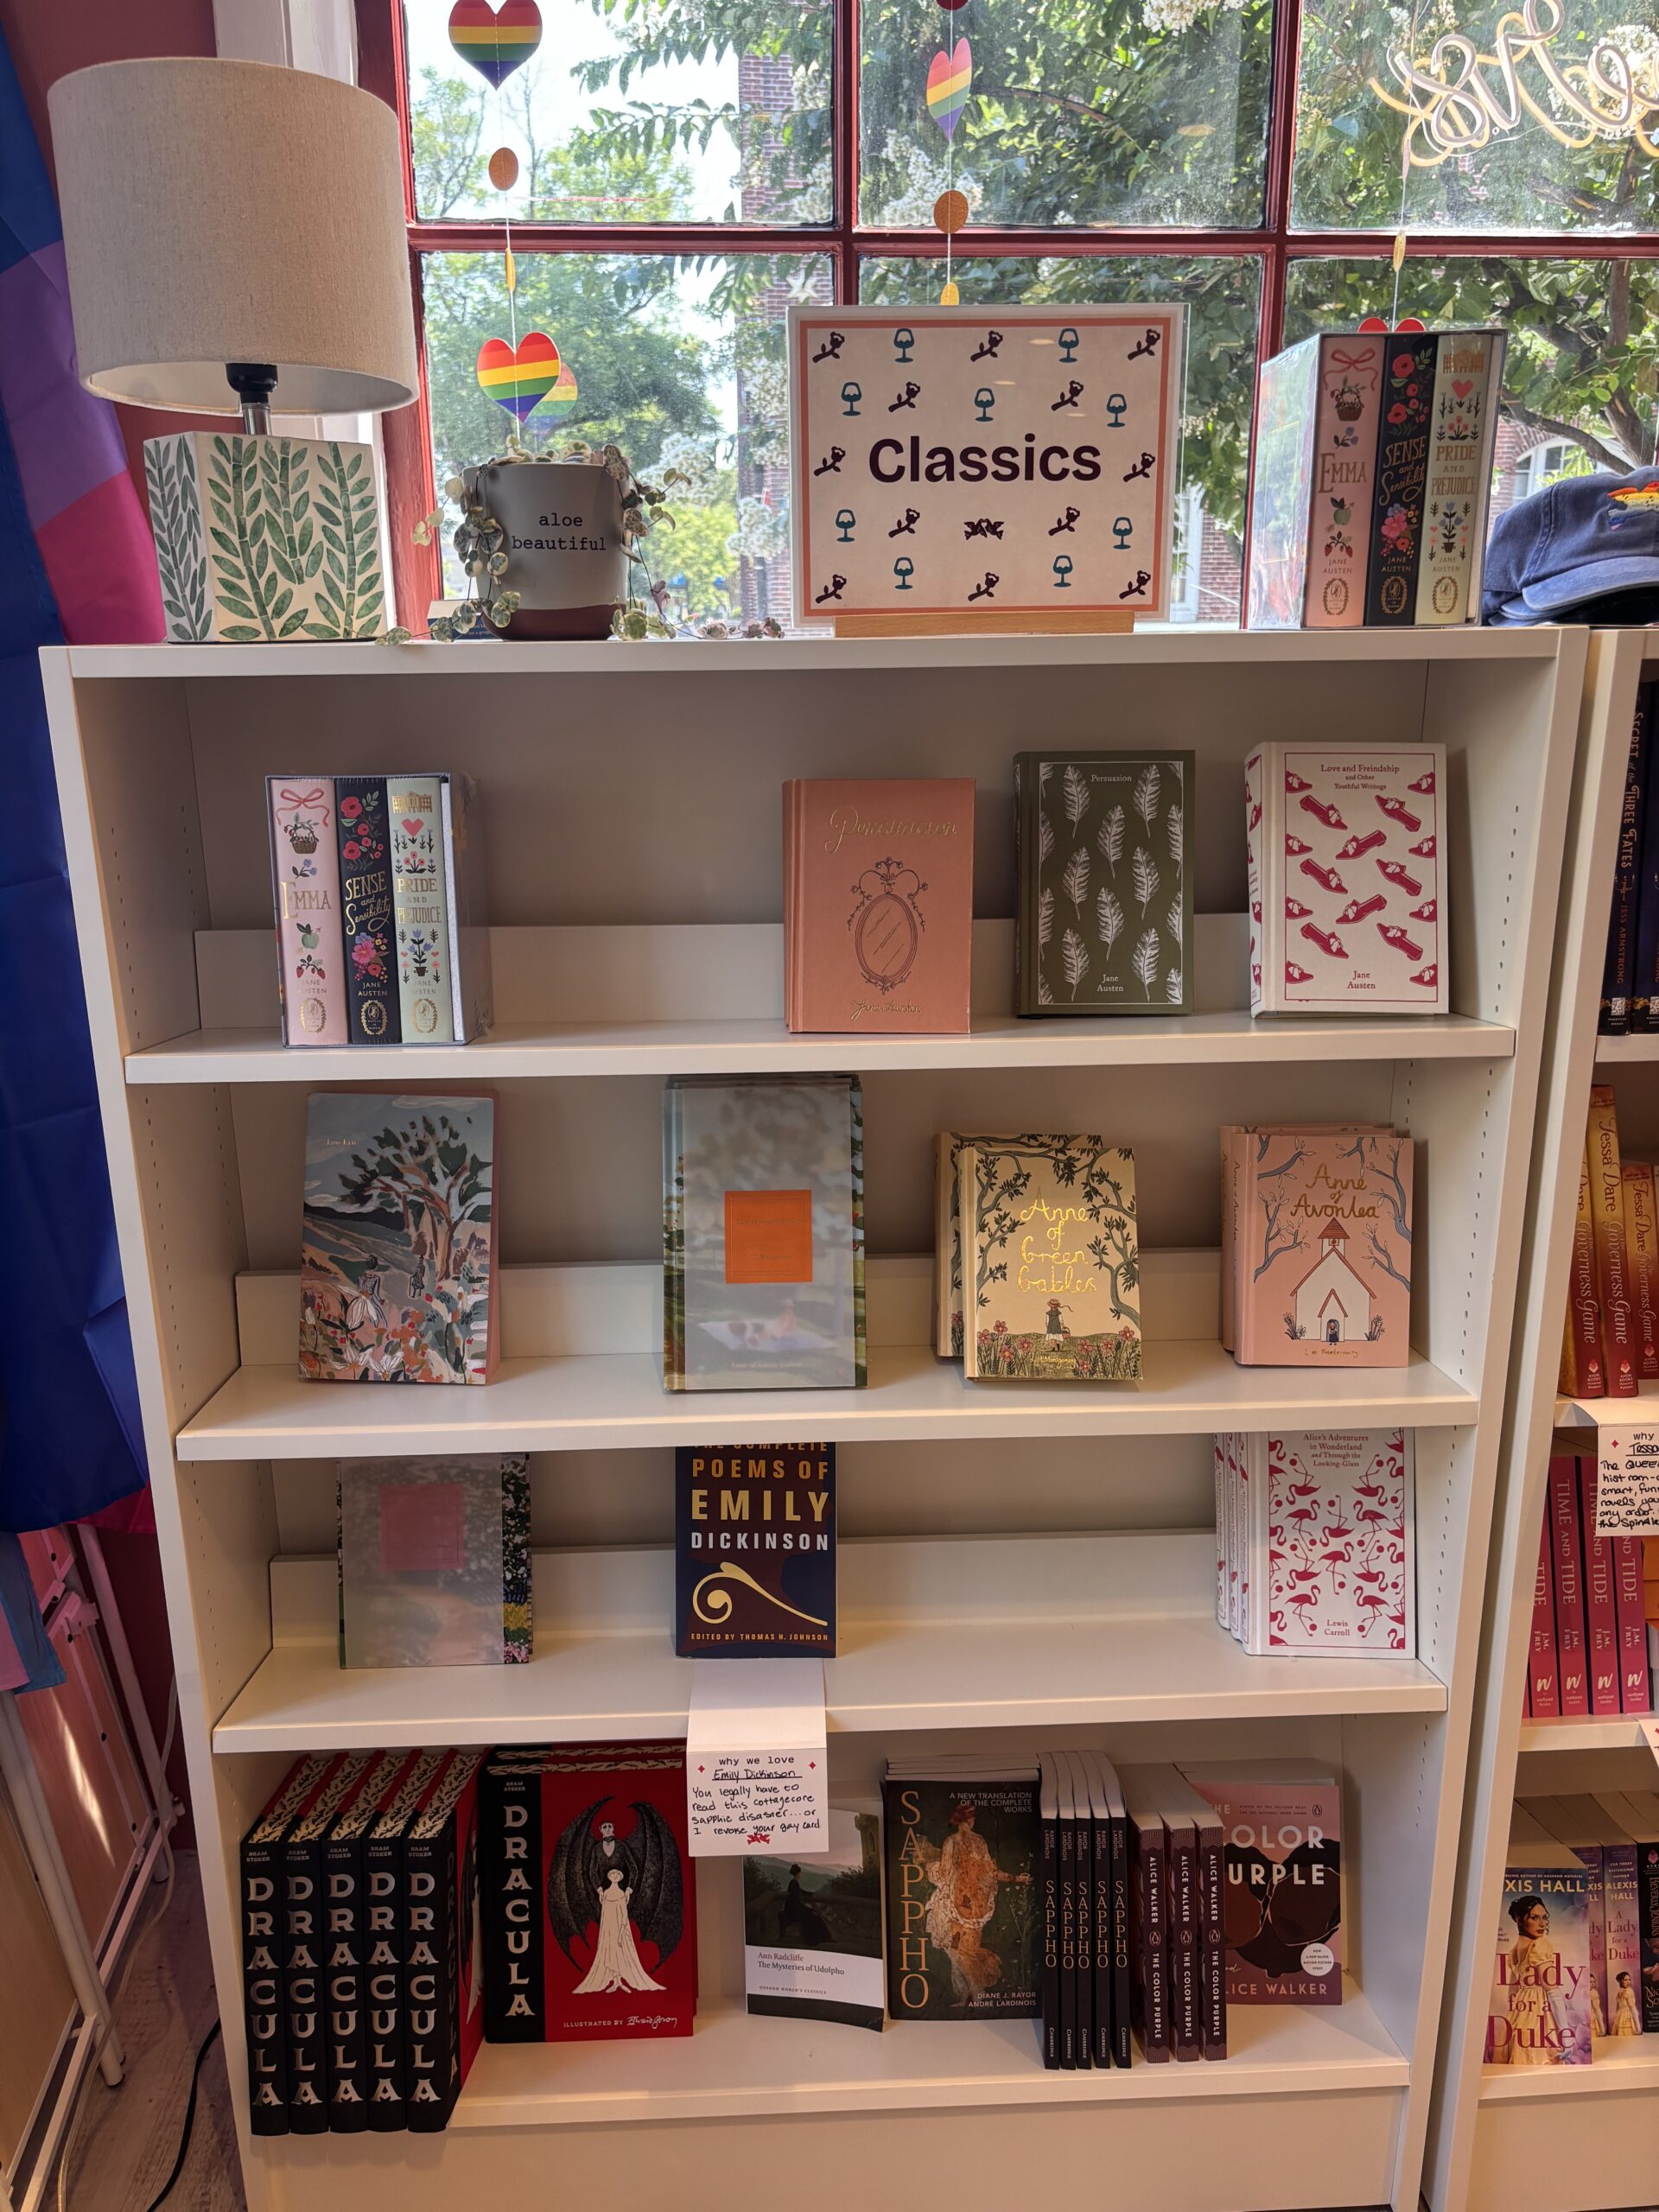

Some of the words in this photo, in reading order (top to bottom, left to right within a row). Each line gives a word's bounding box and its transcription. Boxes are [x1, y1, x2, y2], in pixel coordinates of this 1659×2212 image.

[868, 433, 1102, 483] Classics
[1383, 435, 1426, 468] SENSE
[1436, 445, 1478, 461] PRIDE
[1318, 453, 1367, 493] EMMA
[1379, 465, 1426, 505] Sensibility
[1431, 476, 1477, 495] PREJUDICE
[538, 512, 583, 526] aloe
[512, 536, 606, 550] beautiful
[1320, 764, 1340, 772] Love
[1624, 785, 1639, 823] THREE
[1621, 828, 1637, 868] FATES
[346, 871, 387, 900] SENSE
[397, 878, 438, 893] PRIDE
[280, 881, 332, 919] EMMA
[360, 895, 376, 906] and
[346, 898, 391, 935] Sensibility
[1618, 927, 1626, 983] ARMSTRONG
[1102, 975, 1119, 983] Jane
[1347, 981, 1376, 989] Austen
[1353, 970, 1370, 981] Jane
[1599, 1117, 1617, 1165] Jessa
[1306, 1162, 1367, 1191] Anne
[1603, 1162, 1620, 1212] Dare
[1020, 1186, 1090, 1222] Anne
[1290, 1193, 1380, 1219] Avonlea
[1330, 1190, 1344, 1203] of
[1046, 1220, 1065, 1250] of
[1020, 1236, 1088, 1266] Green
[1603, 1220, 1624, 1297] Governess
[1017, 1265, 1096, 1293] Gables
[1608, 1299, 1630, 1344] Game
[692, 1459, 785, 1478] POEMS
[798, 1460, 829, 1479] OF
[1600, 1460, 1619, 1471] The
[1603, 1473, 1625, 1483] hist
[691, 1490, 829, 1522] EMILY
[1557, 1479, 1571, 1525] TIME
[1600, 1497, 1635, 1507] novels
[691, 1532, 828, 1550] DICKINSON
[1560, 1531, 1571, 1556] AND
[1561, 1560, 1576, 1605] TIDE
[1623, 1558, 1637, 1603] TIDE
[719, 1758, 739, 1766] why
[714, 1769, 740, 1783] Emily
[744, 1769, 796, 1780] Dickinson
[692, 1786, 712, 1798] You
[720, 1785, 751, 1801] legally
[755, 1785, 779, 1794] have
[692, 1801, 715, 1811] read
[725, 1801, 748, 1809] this
[753, 1795, 815, 1811] cottagecore
[1213, 1804, 1230, 1815] HE
[714, 1827, 747, 1835] revoke
[753, 1824, 776, 1835] your
[780, 1823, 799, 1833] gay
[803, 1819, 820, 1829] card
[1224, 1824, 1325, 1849] OLOR
[1229, 1864, 1325, 1885] URPLE
[1540, 1880, 1585, 1892] HALL
[1606, 1881, 1638, 1890] ALEXIS
[502, 1805, 536, 2017] DRACULA
[899, 1790, 930, 2008] SAPPHO
[1046, 1880, 1057, 1968] SAPPHO
[1115, 1880, 1128, 1968] SAPPHO
[1616, 1910, 1623, 1919] A
[1608, 1920, 1638, 1936] Lady
[774, 1953, 804, 1961] Radcliffe
[1609, 1948, 1639, 1960] Duke
[772, 1962, 804, 1972] Mysteries
[814, 1965, 845, 1975] Udolpho
[1496, 1953, 1586, 1999] Lady
[246, 1877, 283, 2107] DRACULA
[407, 1871, 441, 2102] DRACULA
[1225, 1983, 1257, 1994] ICE
[1266, 1983, 1327, 1995] WALKER
[1509, 1993, 1536, 2012] for
[1541, 2001, 1552, 2012] a
[1487, 2015, 1576, 2049] Duke
